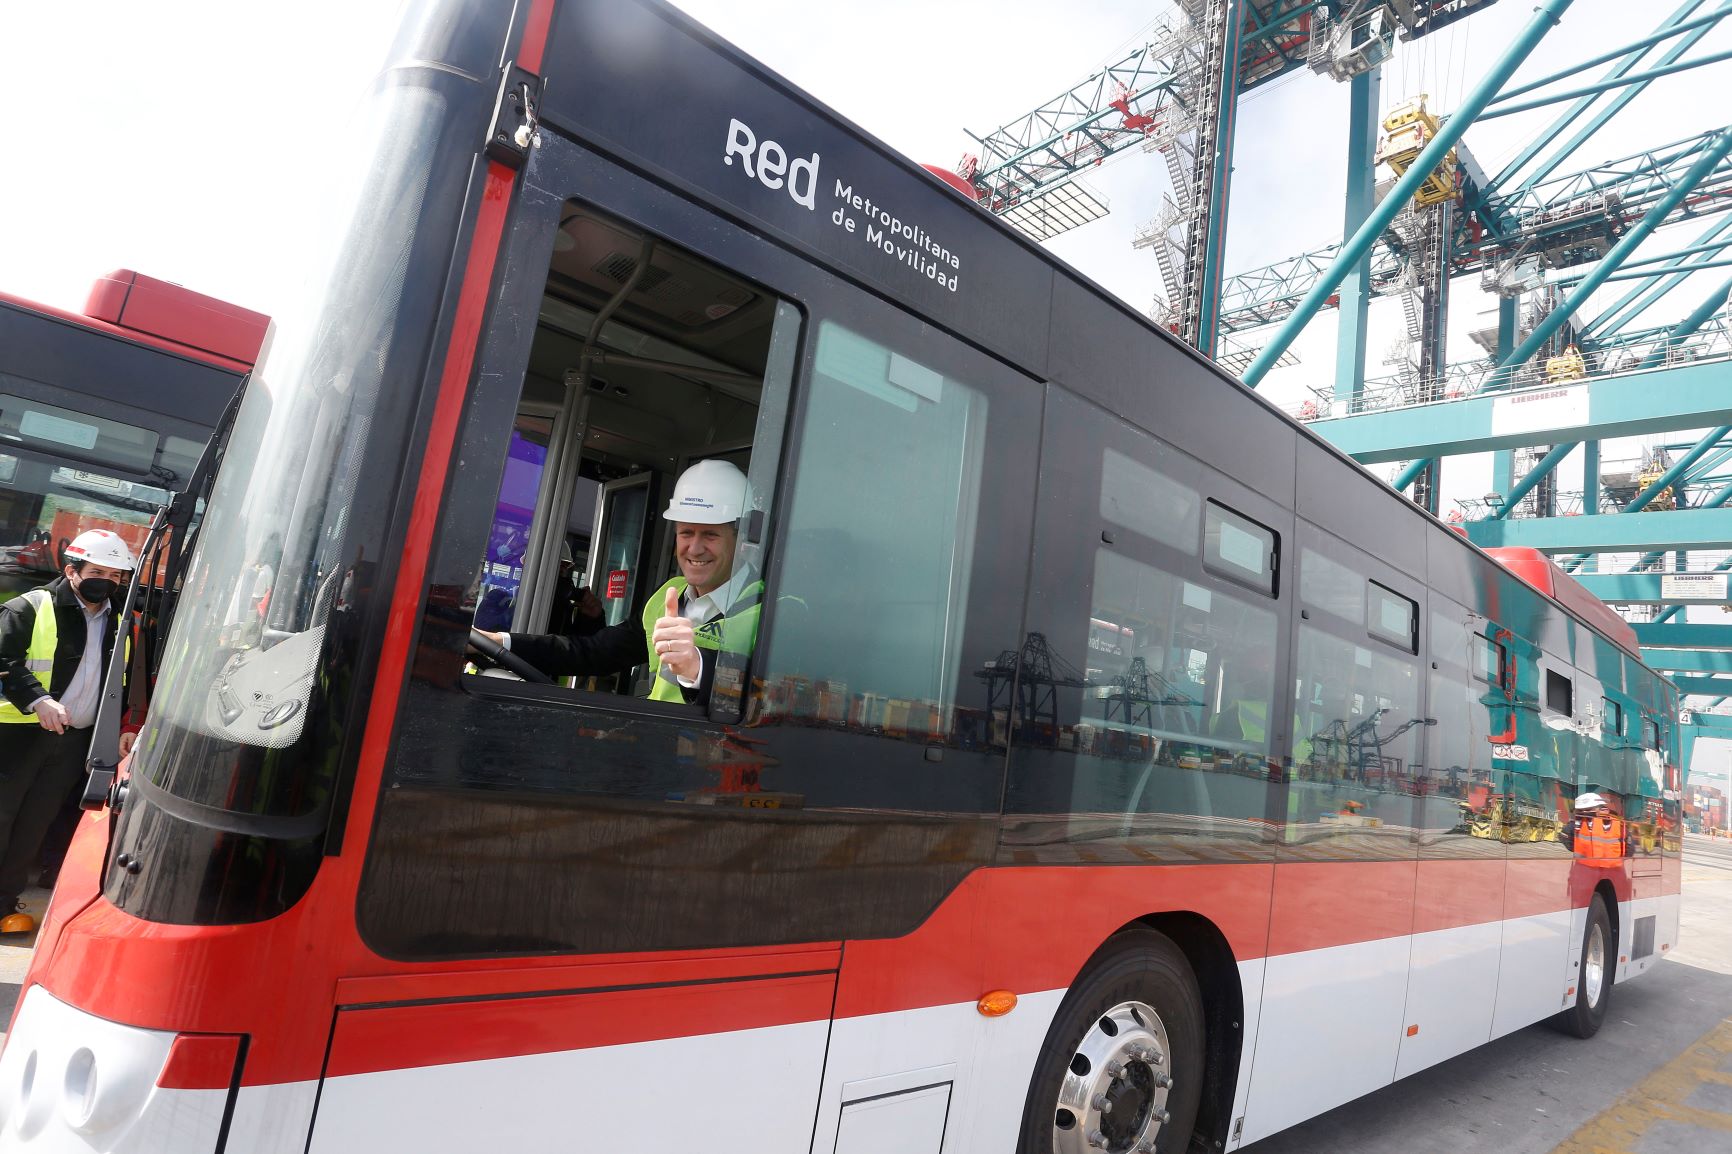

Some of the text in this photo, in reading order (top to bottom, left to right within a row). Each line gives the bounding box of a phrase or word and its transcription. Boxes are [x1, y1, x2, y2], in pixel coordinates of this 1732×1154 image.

[724, 118, 820, 210] Red
[832, 208, 958, 292] de Movilidad
[835, 179, 960, 269] Metropolitana
[1511, 390, 1568, 404] LIEBHERR
